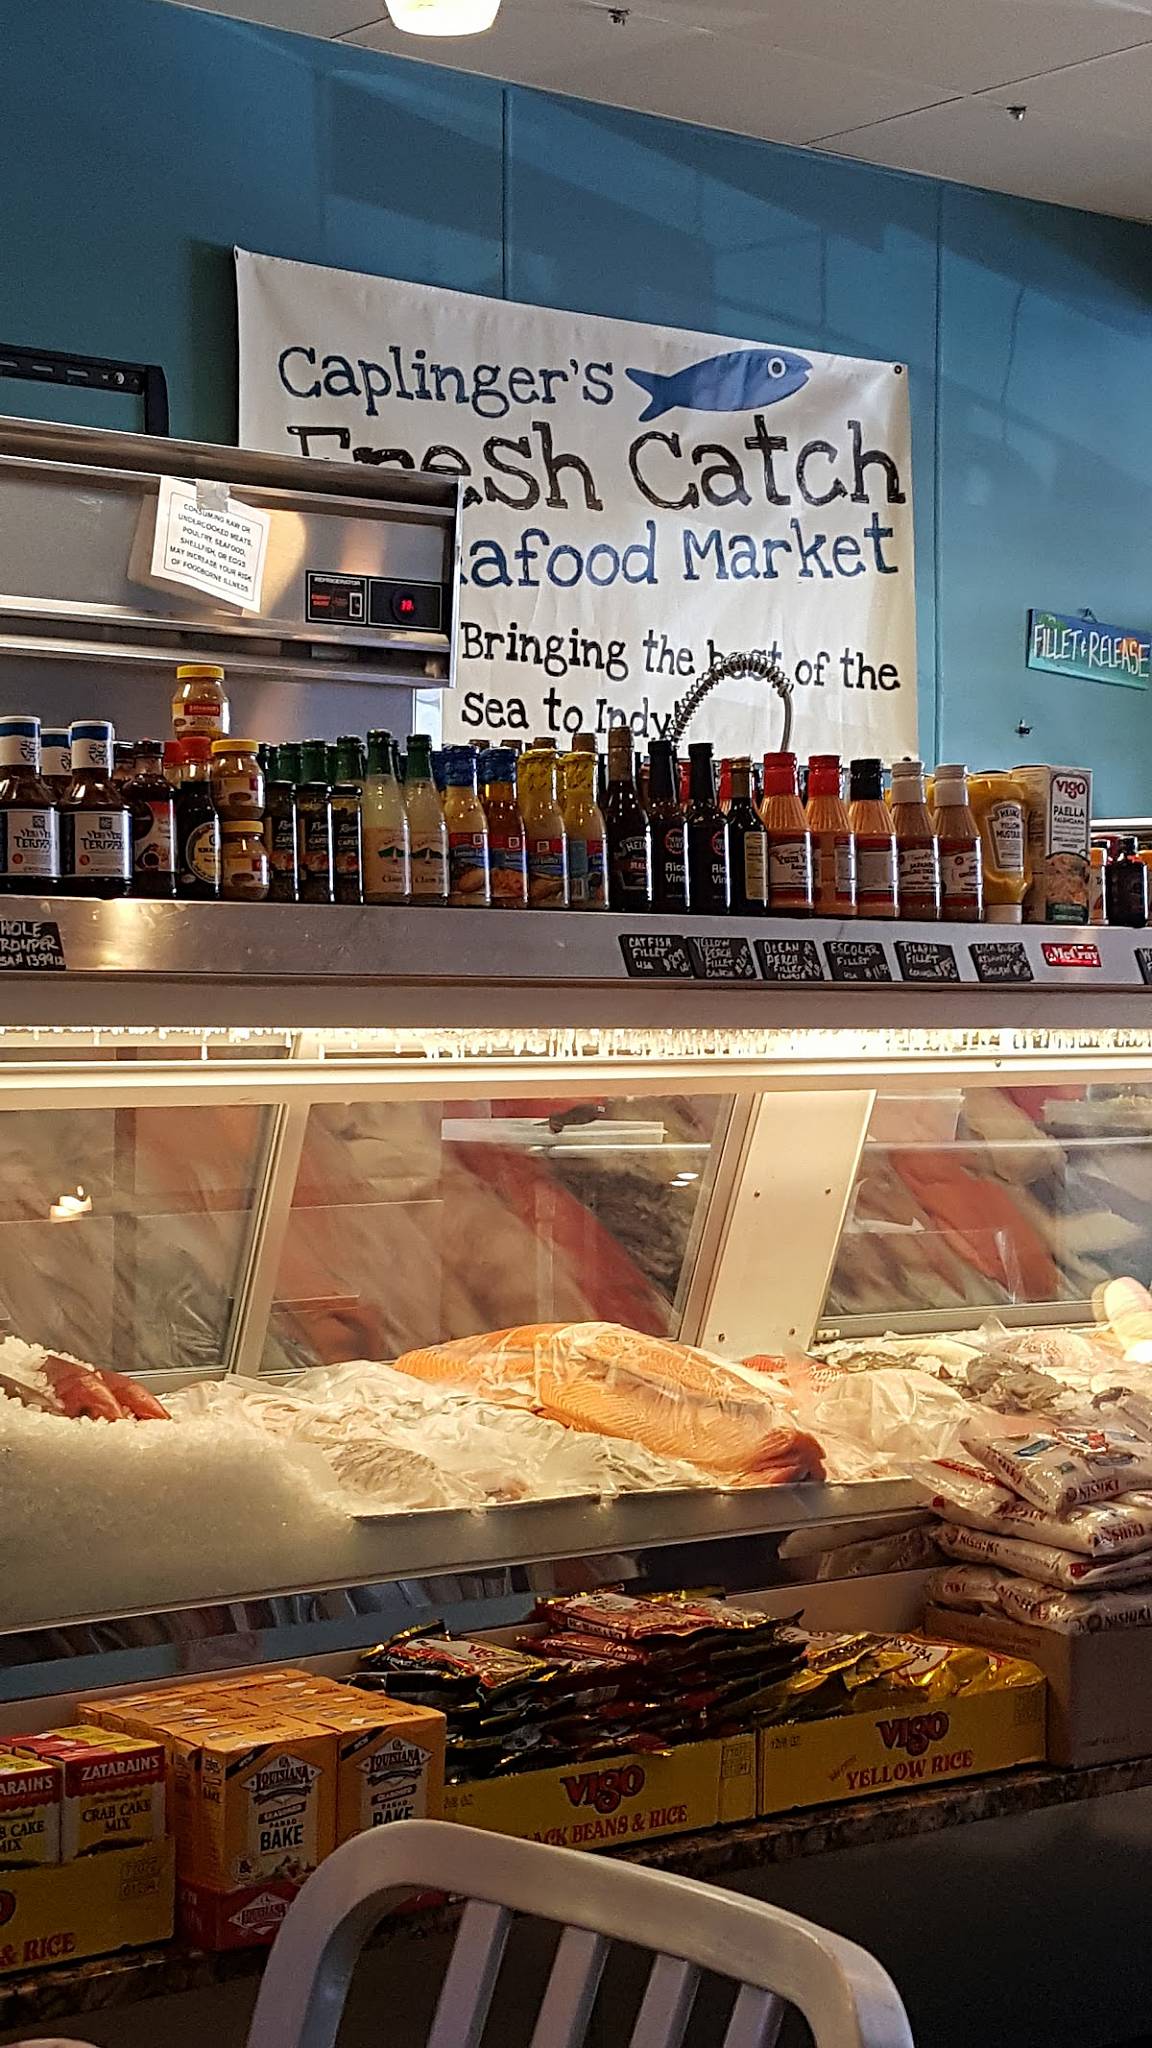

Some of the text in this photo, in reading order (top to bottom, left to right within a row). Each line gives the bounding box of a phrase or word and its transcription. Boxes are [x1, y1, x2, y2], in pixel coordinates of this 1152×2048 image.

[279, 345, 614, 417] Caplinger's
[629, 415, 907, 510] Catch
[183, 503, 225, 523] CONSUMING
[684, 512, 898, 581] Market
[460, 622, 629, 681] Bringing
[643, 629, 696, 676] the
[795, 650, 830, 687] of
[840, 647, 901, 691] the
[1033, 623, 1083, 661] FILLET
[1087, 631, 1150, 678] RELEASE
[543, 687, 583, 733] to
[1053, 805, 1085, 817] PAELLA
[628, 937, 672, 949] CATFISH
[632, 947, 668, 960] FILLET
[829, 942, 880, 957] ESCOLAR
[836, 956, 870, 967] FILLET
[906, 952, 940, 965] FILLET
[368, 1748, 422, 1774] LOUISIANA
[846, 1760, 926, 1790] YELLOW
[931, 1750, 973, 1775] RICE
[255, 1764, 313, 1793] LOUISIANA
[10, 1819, 44, 1837] CAKE
[82, 1806, 116, 1823] CRAB
[103, 1817, 132, 1834] MIX
[572, 1817, 628, 1844] BEANS
[634, 1811, 645, 1831] &
[649, 1804, 688, 1830] RICE
[259, 1823, 304, 1852] BAKE
[23, 1932, 76, 1962] RICE
